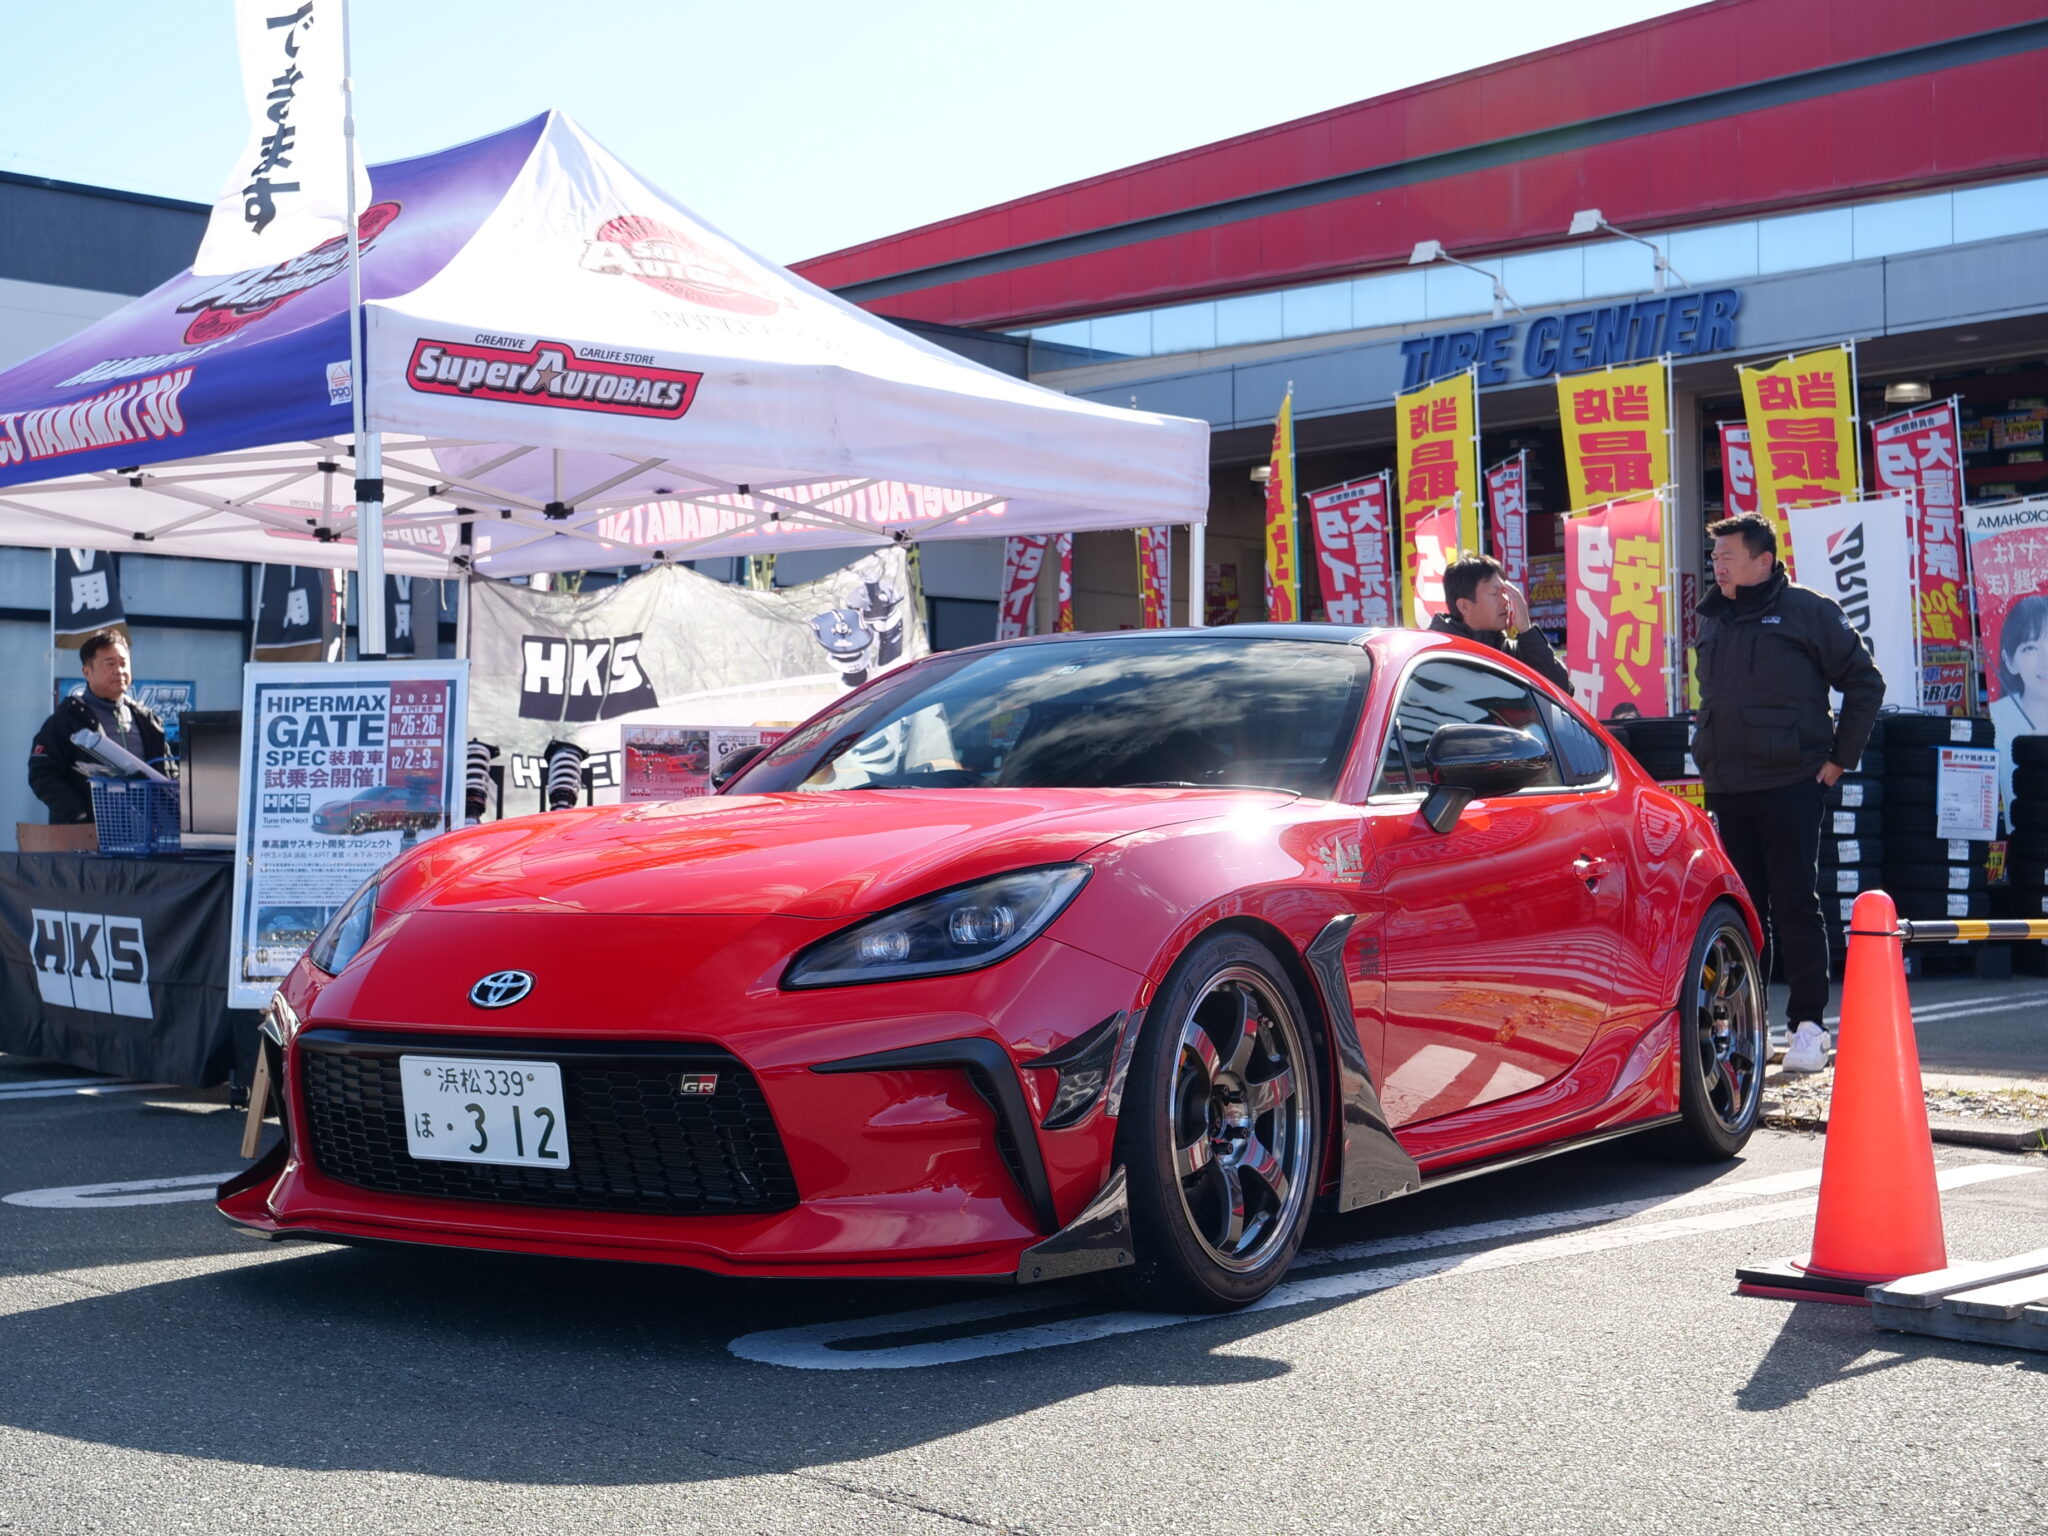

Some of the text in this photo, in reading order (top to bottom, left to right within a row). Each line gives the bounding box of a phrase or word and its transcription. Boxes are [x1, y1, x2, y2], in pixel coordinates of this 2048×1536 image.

[243, 1, 314, 235] できます
[474, 333, 656, 366] CREATIVE CARLIFE STORE
[1400, 288, 1744, 393] TIRE CENTER
[523, 637, 646, 703] HKS
[266, 695, 386, 713] HIPERMAX
[267, 714, 386, 748] GATE
[265, 750, 326, 766] SPEC
[263, 794, 311, 811] HKS
[33, 917, 146, 988] HKS
[682, 1081, 715, 1094] GR
